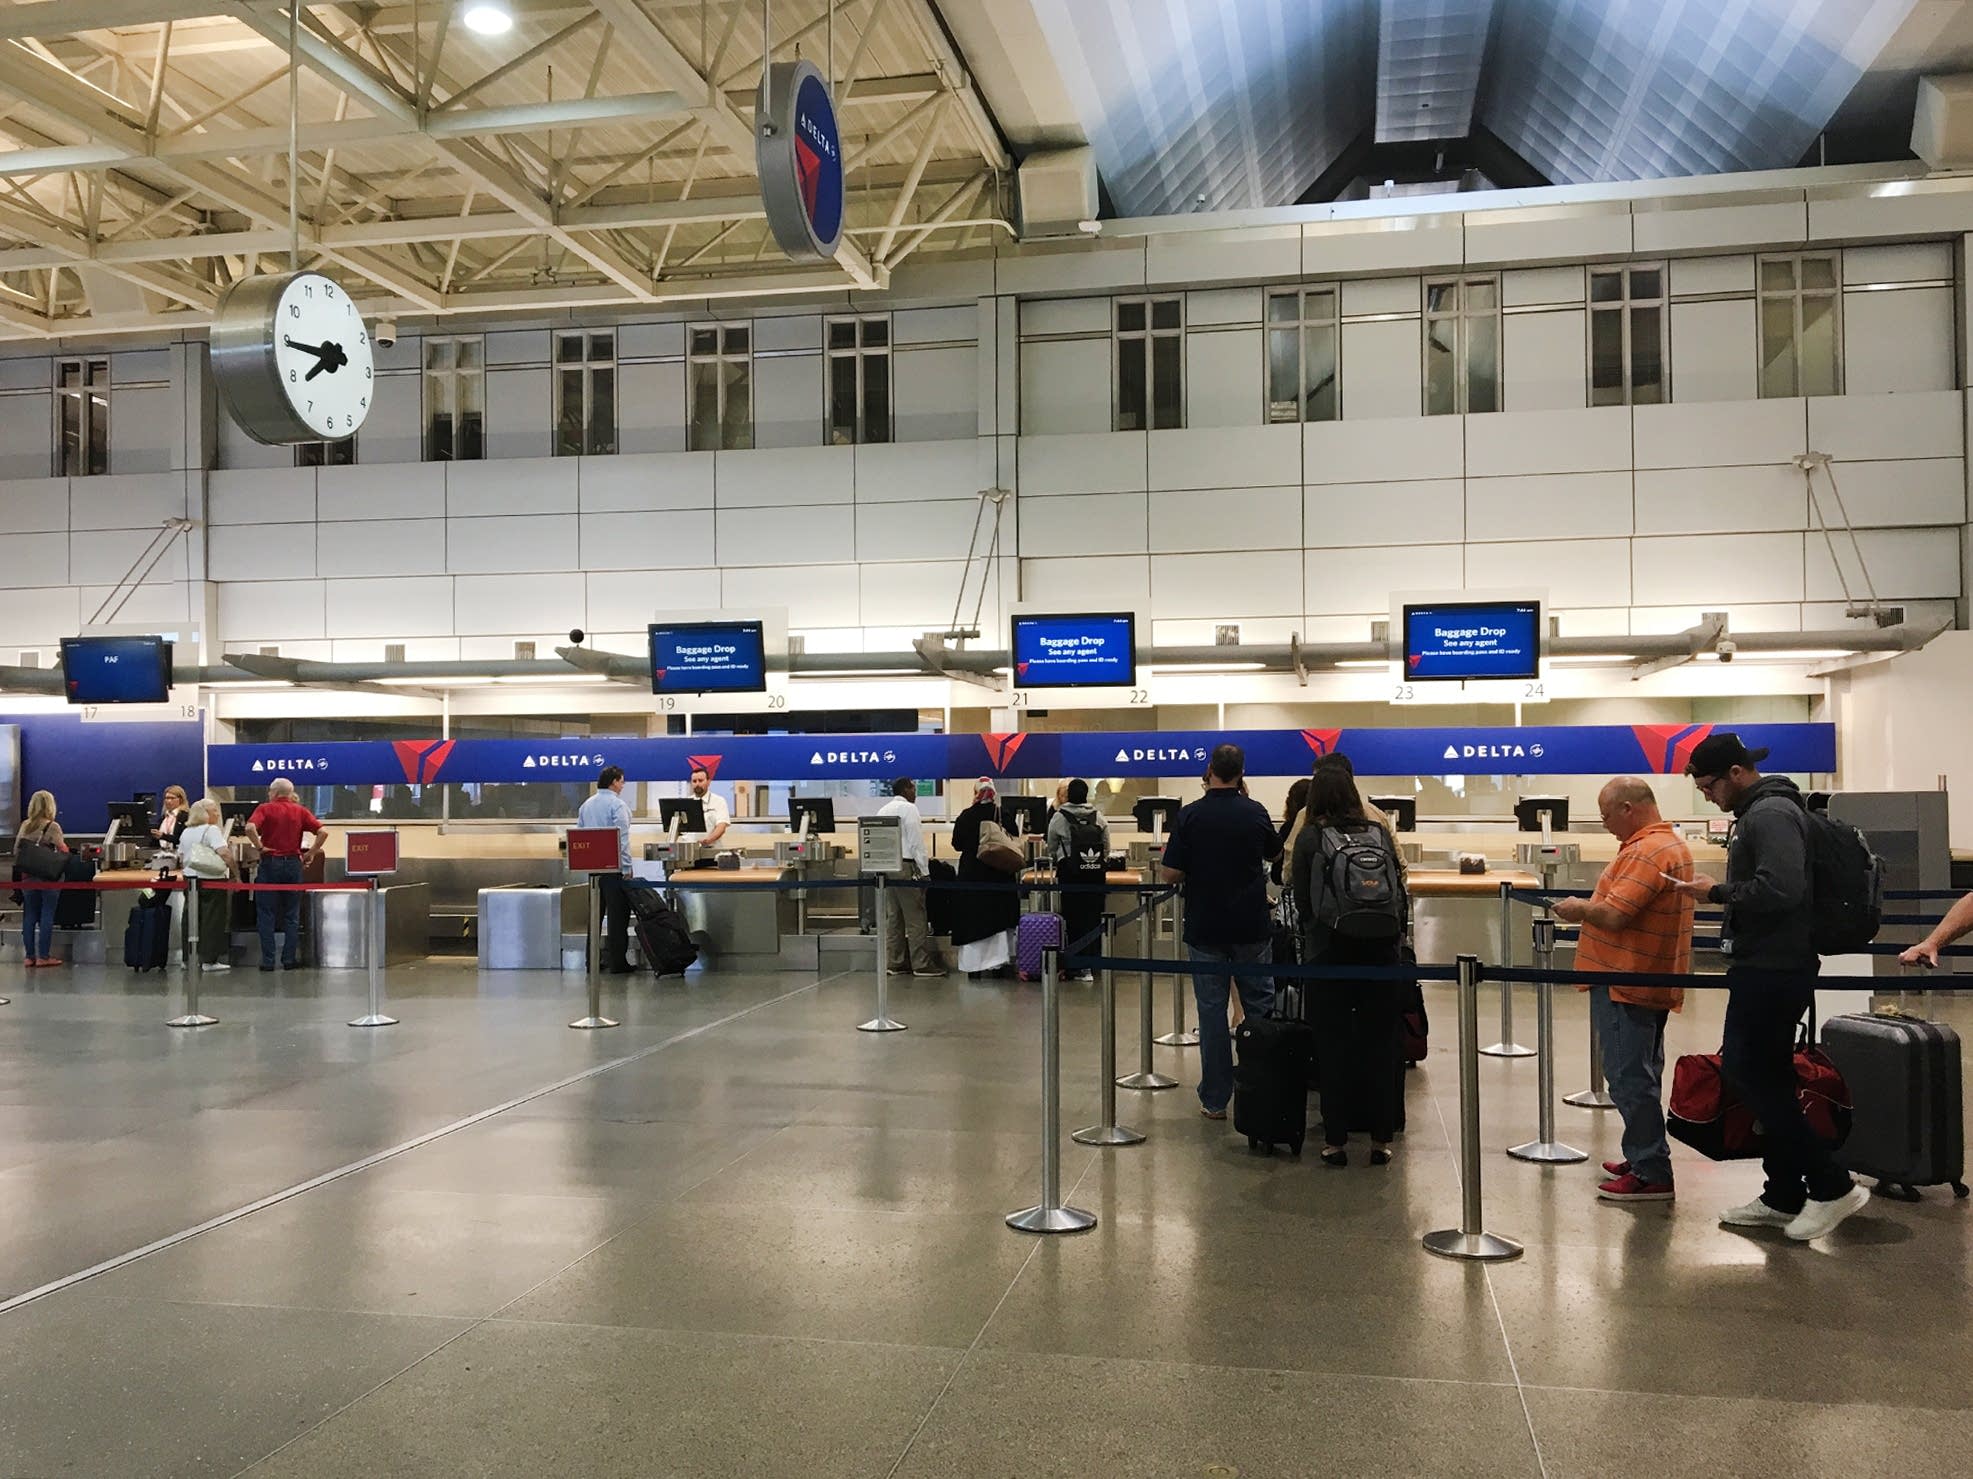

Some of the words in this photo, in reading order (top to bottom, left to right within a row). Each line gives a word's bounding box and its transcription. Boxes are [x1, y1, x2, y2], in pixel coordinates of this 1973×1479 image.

[807, 119, 830, 155] DELTA
[304, 284, 312, 298] 11
[324, 284, 334, 298] 12
[289, 304, 300, 319] 10
[346, 304, 351, 316] 1
[360, 332, 366, 344] 2
[290, 369, 296, 383] 8
[366, 366, 372, 379] 3
[307, 400, 313, 412] 7
[360, 397, 366, 408] 4
[326, 416, 333, 430] 6
[346, 414, 352, 427] 5
[1435, 628, 1478, 638] Baggage
[1480, 627, 1506, 637] Drop
[1040, 637, 1080, 647] Baggage
[1081, 636, 1105, 646] Drop
[1475, 639, 1498, 647] agent
[676, 646, 712, 654] Baggage
[714, 644, 736, 654] Drop
[1077, 648, 1097, 656] agent
[1395, 686, 1414, 700] 23
[1525, 683, 1544, 697] 24
[660, 698, 675, 710] 19
[768, 695, 785, 708] 20
[1012, 692, 1028, 706] 21
[1130, 690, 1148, 704] 22
[84, 707, 98, 719] 17
[181, 705, 195, 718] 18
[1134, 749, 1189, 760] DELTA
[1463, 745, 1525, 757] DELTA
[540, 755, 589, 766] DELTA
[828, 752, 880, 763] DELTA
[267, 760, 314, 770] DELTA
